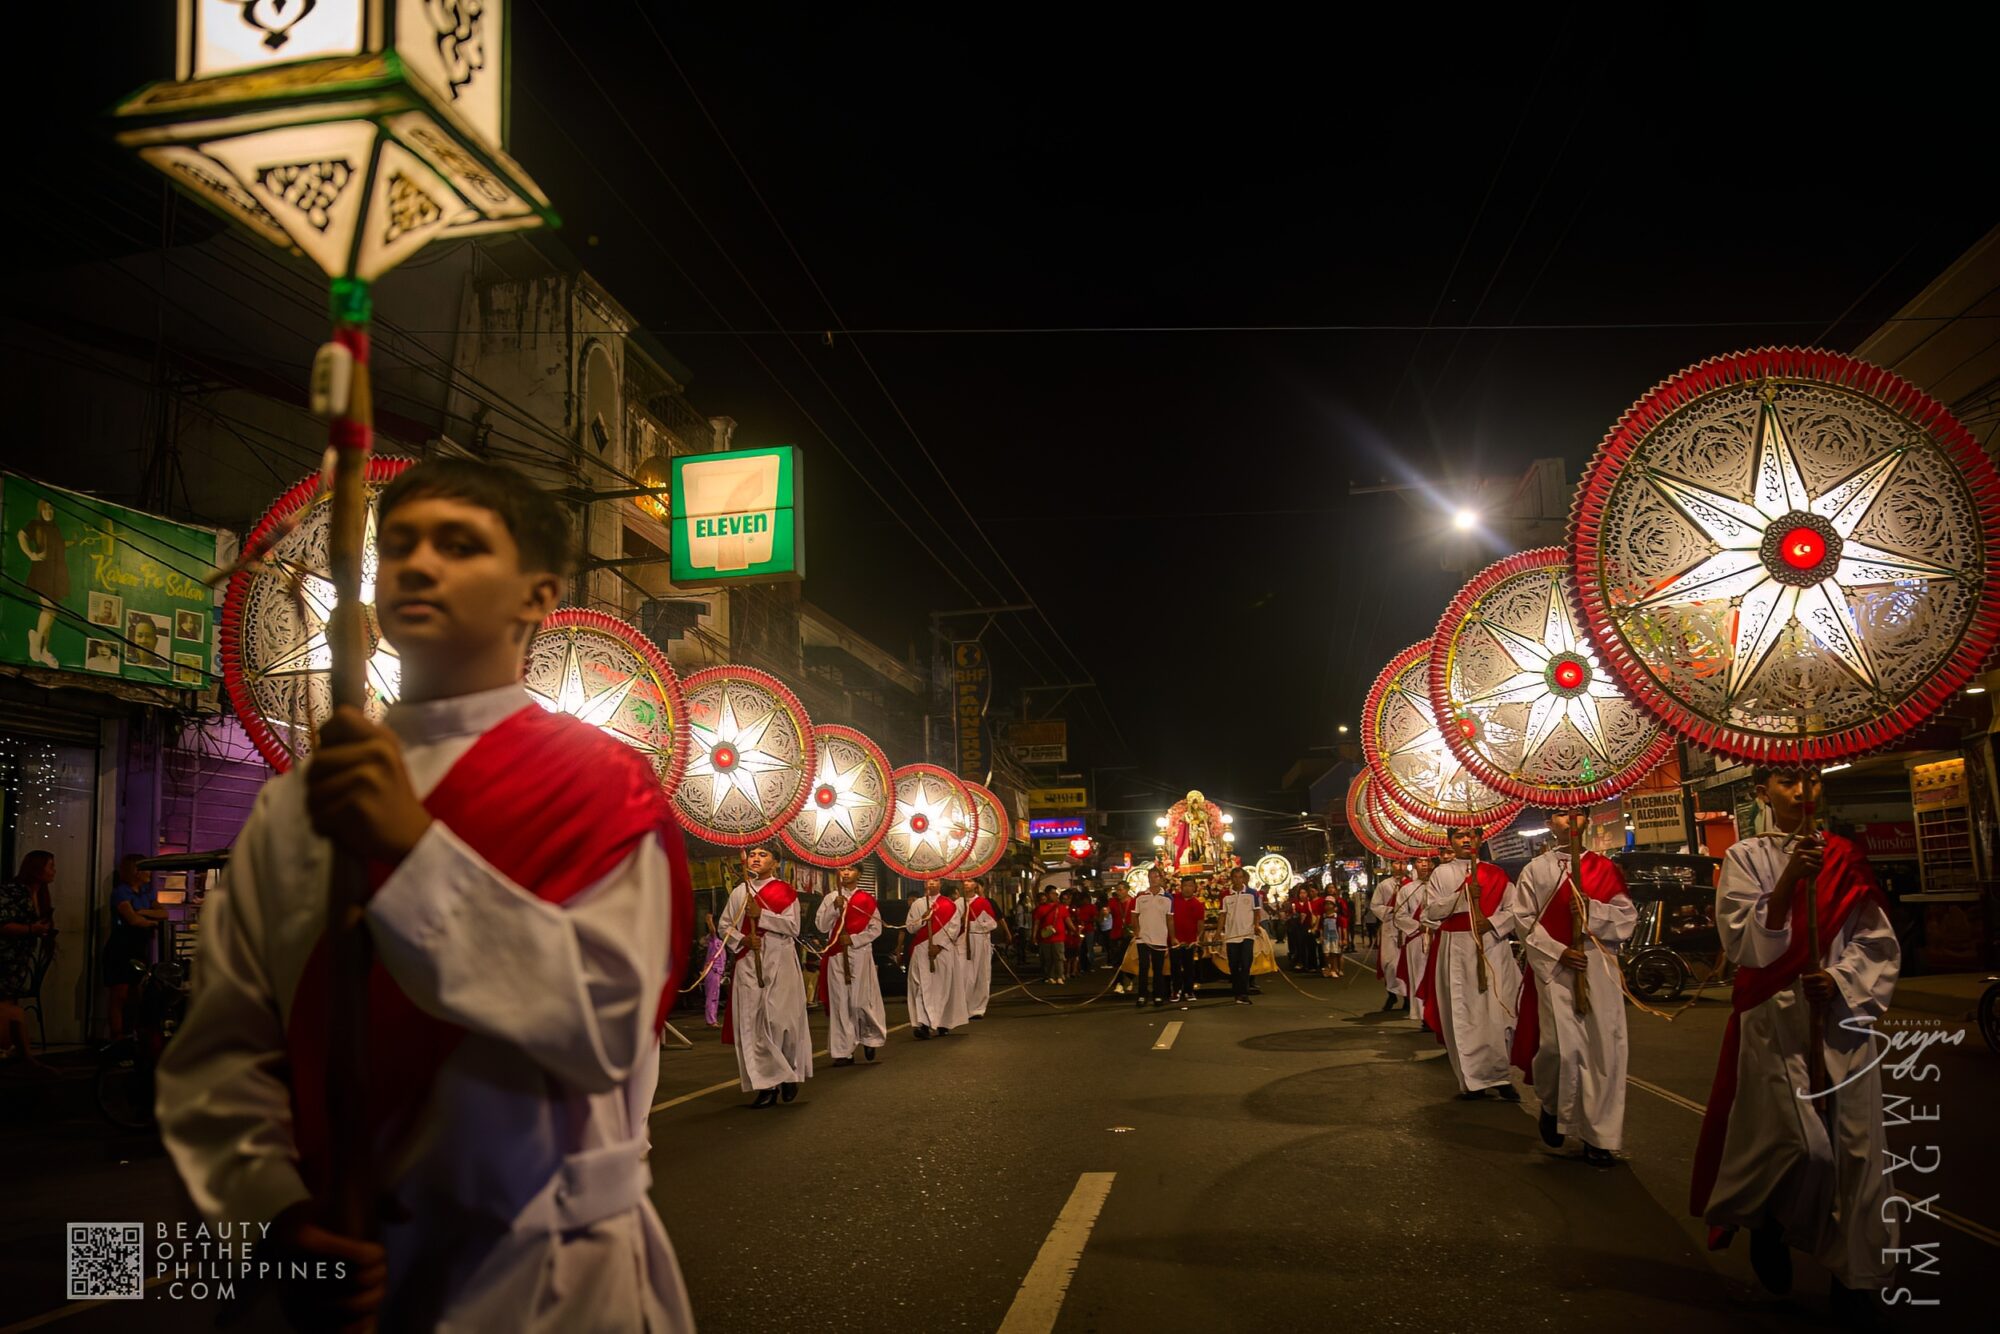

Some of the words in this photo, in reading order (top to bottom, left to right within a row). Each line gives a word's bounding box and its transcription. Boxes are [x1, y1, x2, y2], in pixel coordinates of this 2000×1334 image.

[165, 573, 204, 601] Salon
[1631, 794, 1681, 808] FACEMASK
[1637, 807, 1678, 819] ALCOHOL
[1865, 835, 1915, 850] Winston
